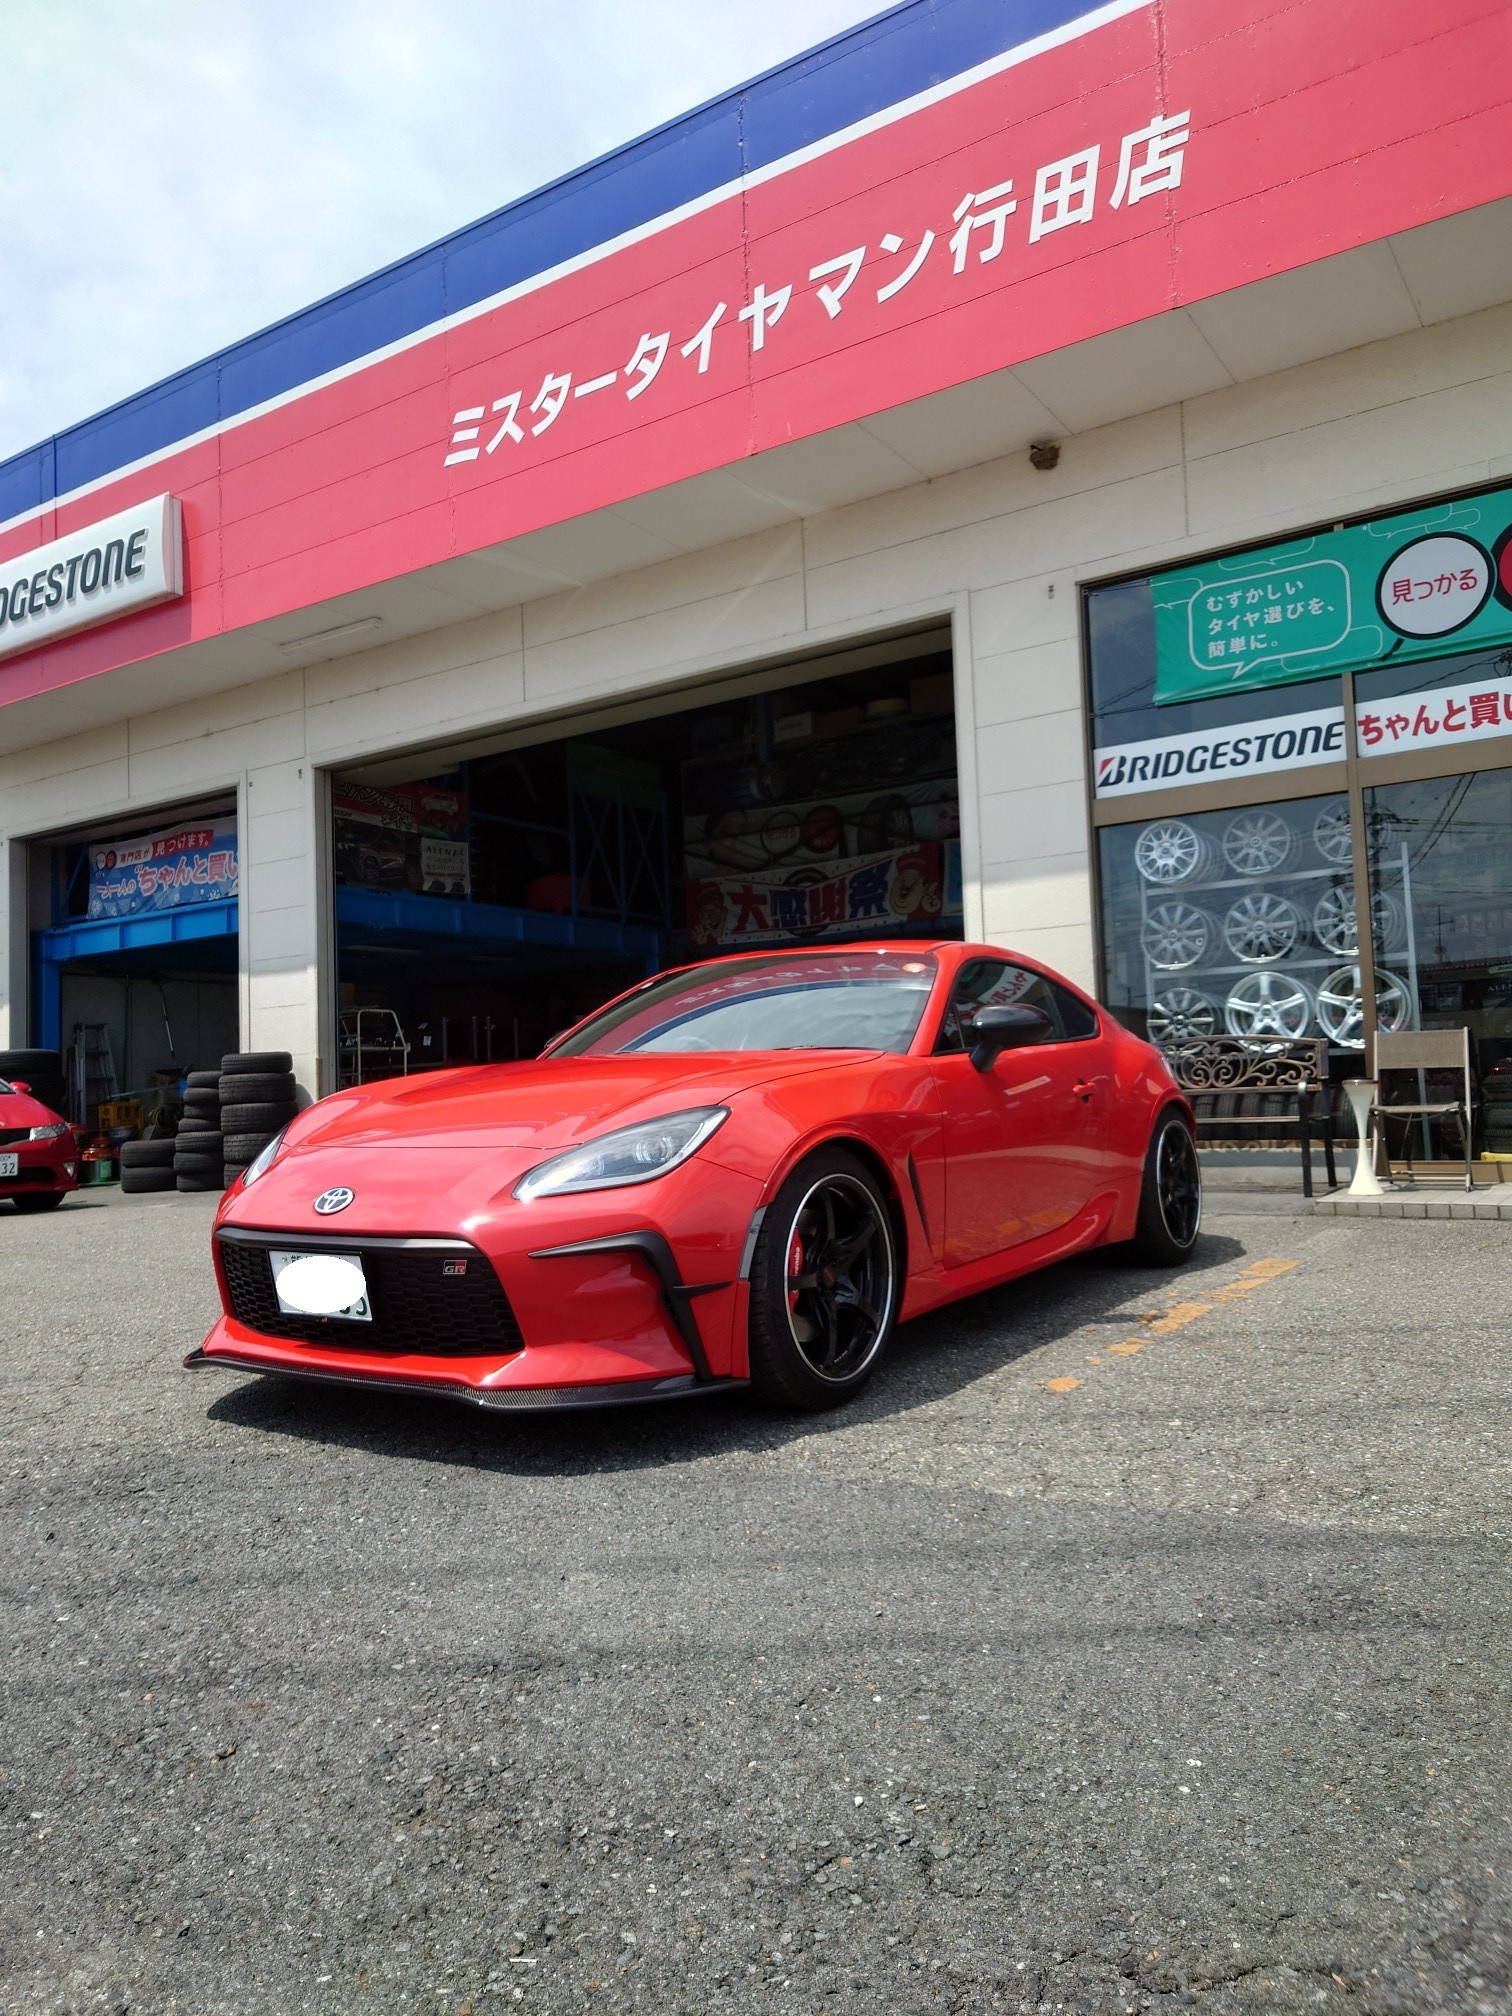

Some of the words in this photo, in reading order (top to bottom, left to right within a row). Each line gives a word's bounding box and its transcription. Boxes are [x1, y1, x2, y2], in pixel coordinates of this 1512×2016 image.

[444, 110, 1191, 467] ミスタータイヤマン行田店
[1392, 568, 1478, 605] 見つかる
[1208, 598, 1334, 635] タイヤ選びを、
[1208, 634, 1278, 658] 簡単に。
[1097, 721, 1345, 788] BRIDGESTONE
[726, 859, 894, 933] 大感謝祭
[444, 1265, 465, 1273] GR
